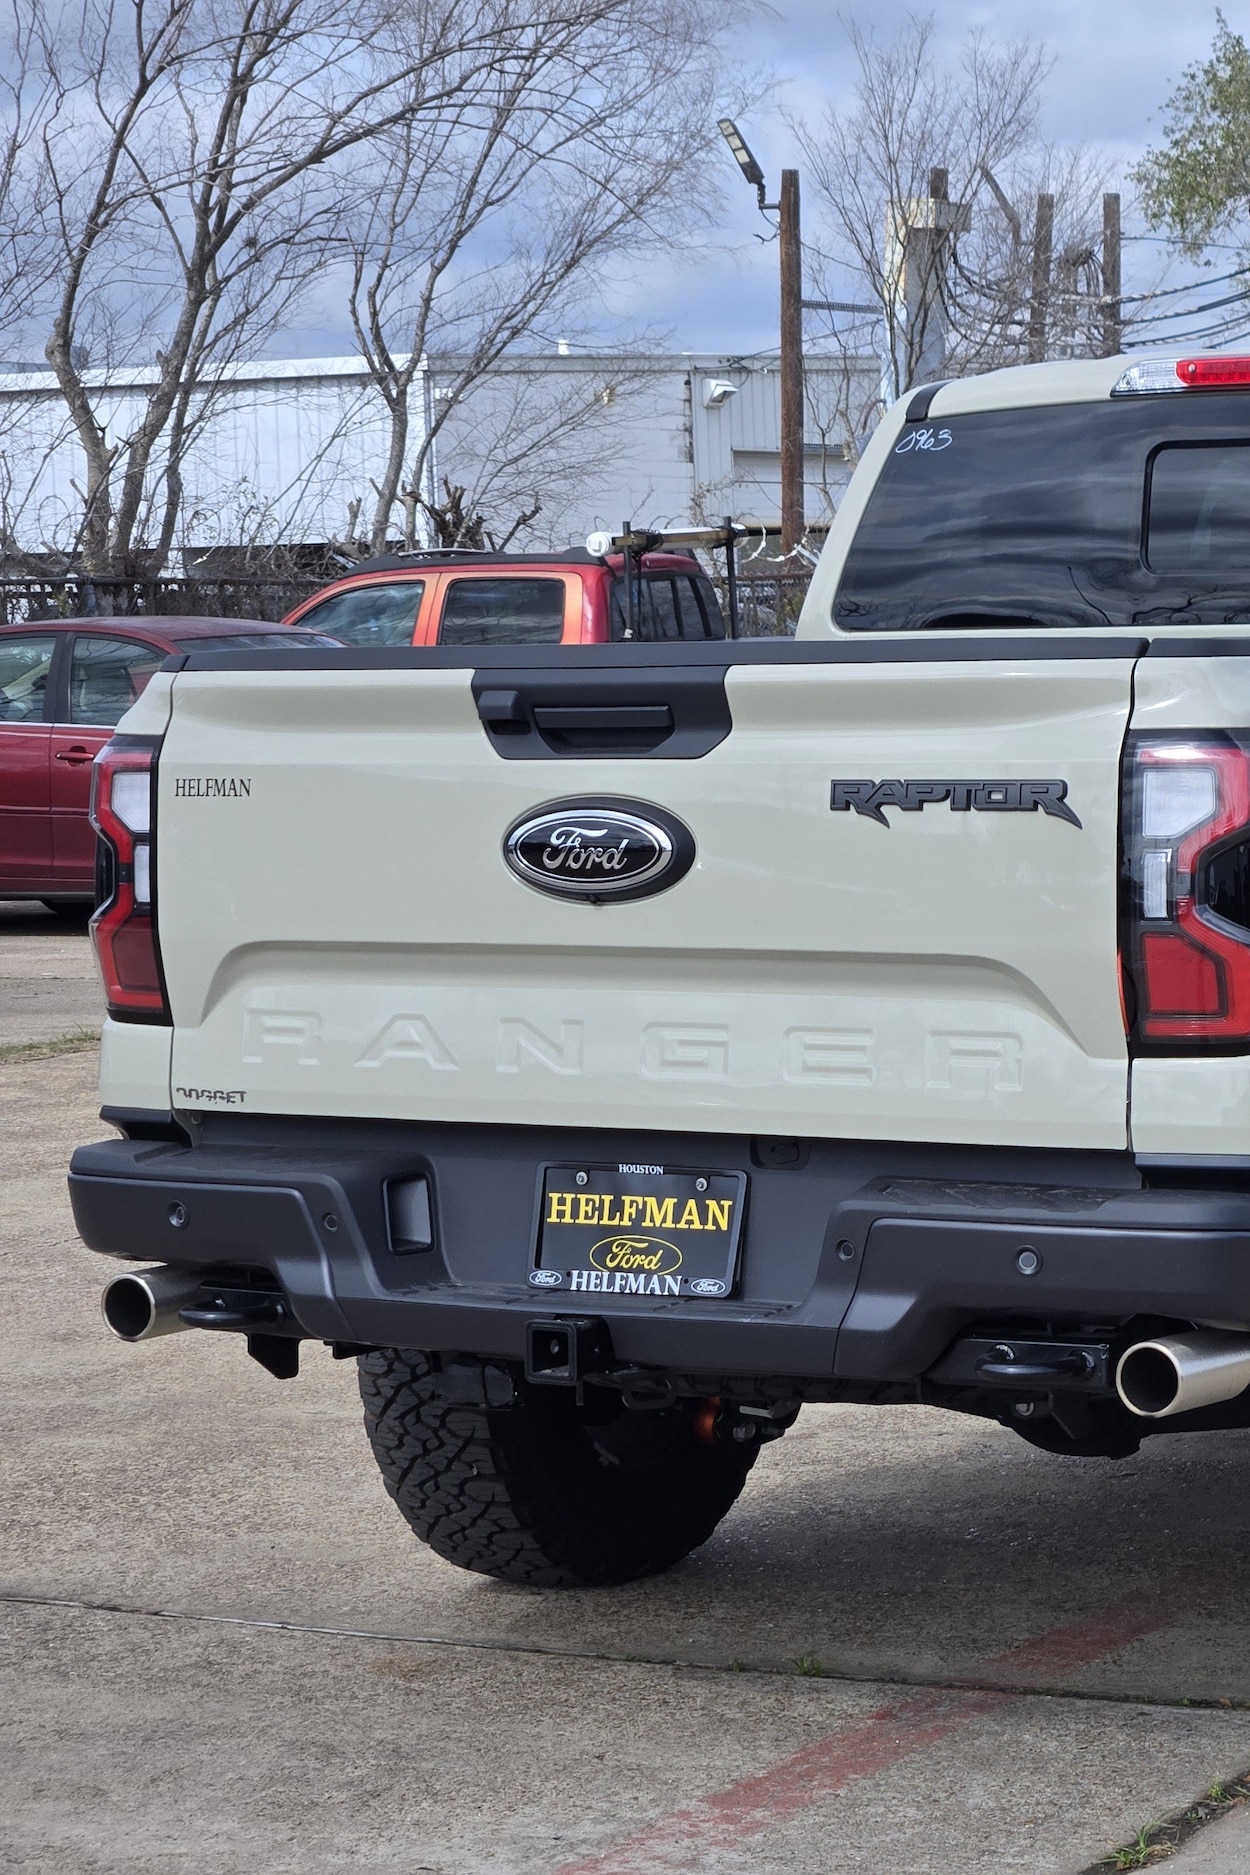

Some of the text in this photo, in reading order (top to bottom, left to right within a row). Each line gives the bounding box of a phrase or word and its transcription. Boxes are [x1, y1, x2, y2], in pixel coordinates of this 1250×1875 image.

[175, 778, 251, 798] HELFMAN
[830, 779, 1082, 829] RAPTOR
[543, 826, 629, 872] Ford
[242, 1007, 1023, 1093] RANGER
[618, 1163, 664, 1175] HOUSTON
[547, 1192, 732, 1231] HELFMAN
[605, 1239, 664, 1270] Ford
[535, 1273, 556, 1285] Ford
[570, 1270, 682, 1296] HELFMAN
[697, 1281, 720, 1294] Ford
